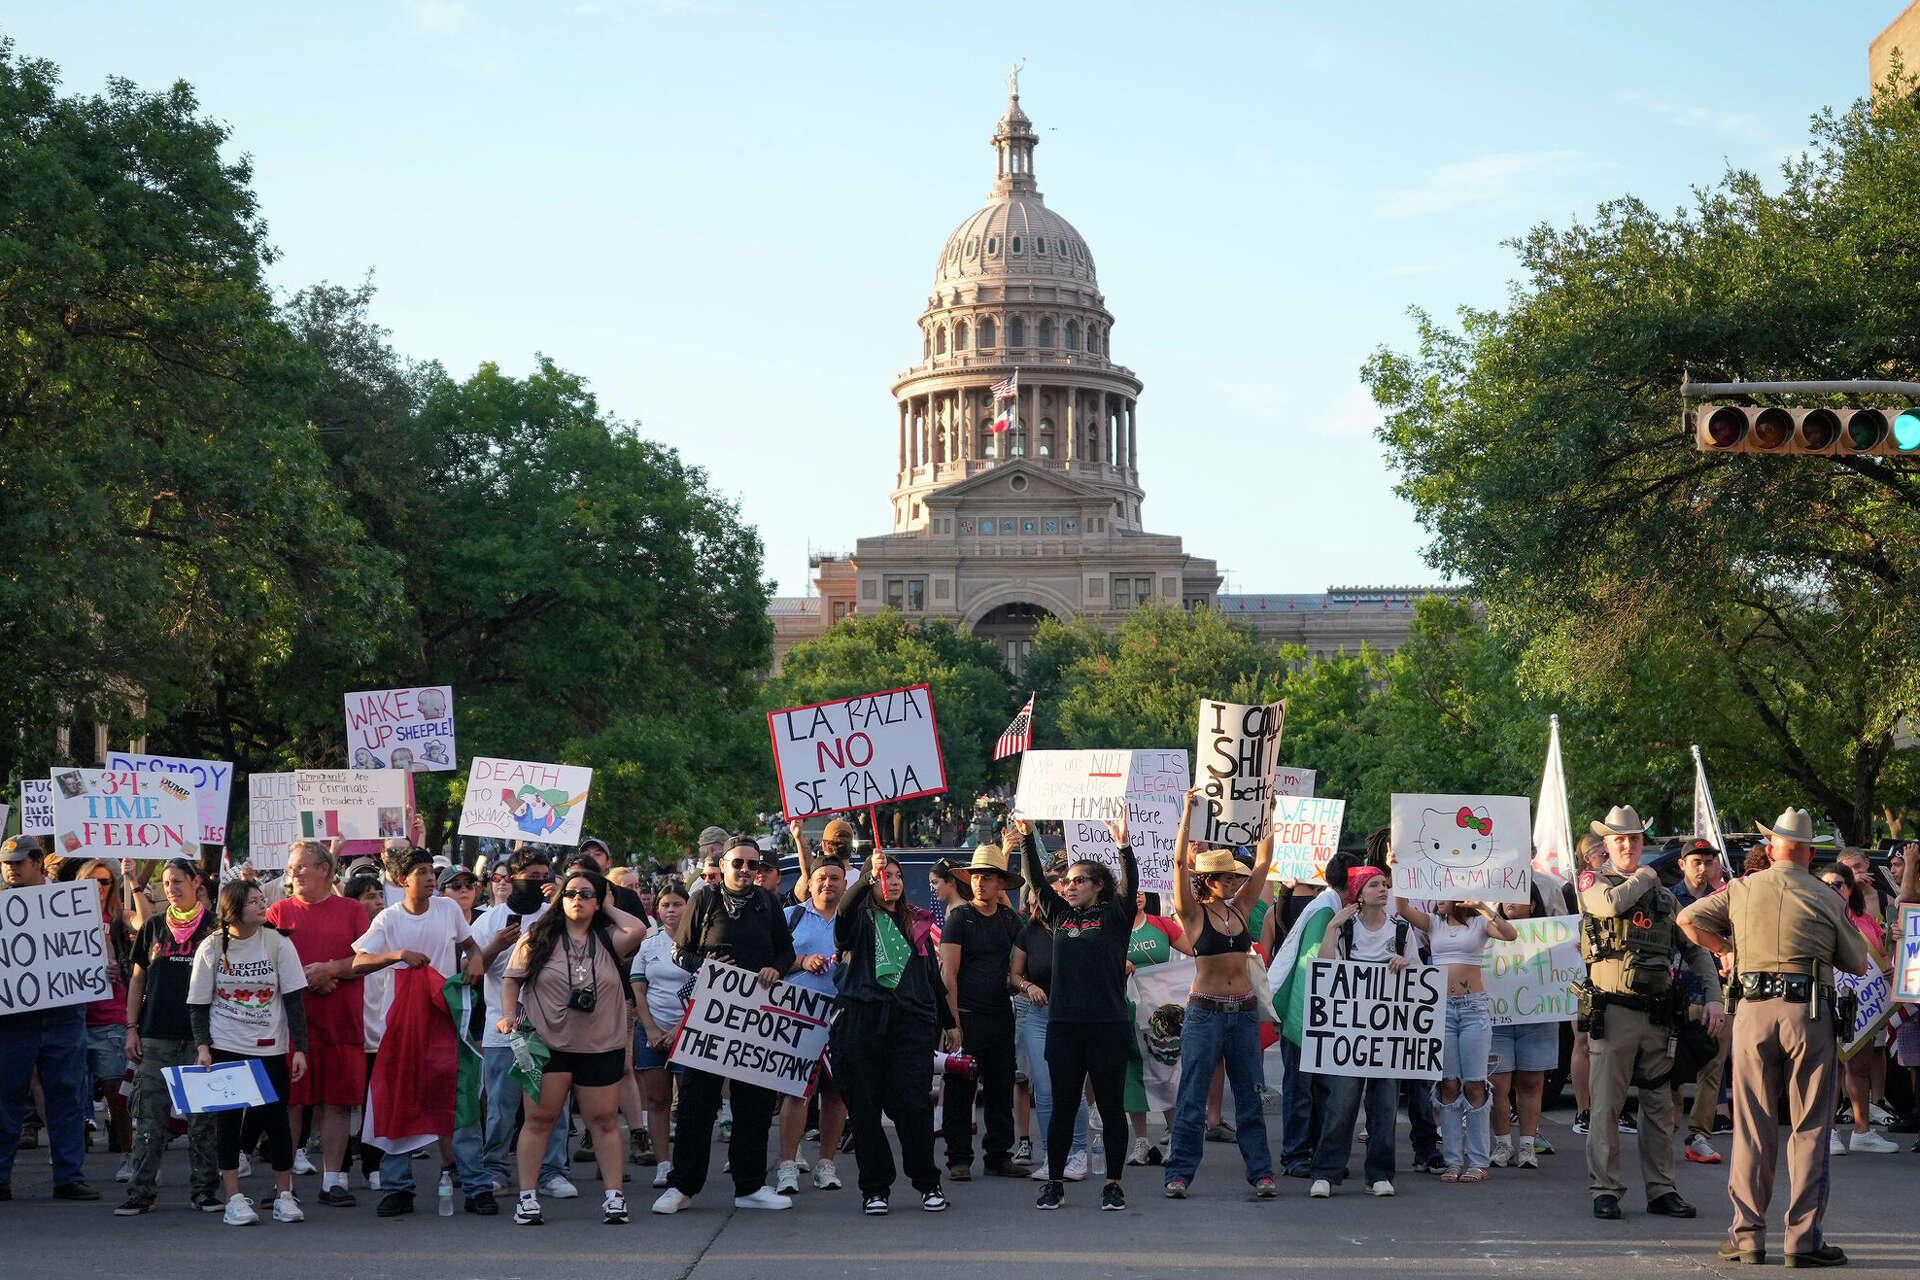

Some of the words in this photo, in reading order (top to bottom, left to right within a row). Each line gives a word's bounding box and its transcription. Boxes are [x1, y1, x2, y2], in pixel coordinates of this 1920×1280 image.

[347, 691, 414, 731] WAKE
[786, 705, 835, 742] LA
[844, 689, 923, 731] RAZA
[1210, 703, 1226, 735] I
[363, 725, 393, 750] UP
[396, 717, 453, 741] SHEEPLE!
[816, 732, 874, 773] NO
[1090, 753, 1122, 774] NOT
[1157, 753, 1185, 775] IS
[1206, 735, 1277, 779] SHIT
[101, 772, 139, 796] 34
[297, 783, 311, 792] Not
[475, 760, 561, 788] DEATH
[25, 794, 47, 804] NO
[297, 795, 314, 806] The
[471, 788, 492, 801] TO
[794, 778, 833, 816] SE
[839, 764, 923, 808] RAJA
[1231, 778, 1272, 801] bette
[82, 796, 162, 819] TIME
[1071, 796, 1125, 819] HUMANS
[1129, 803, 1164, 825] Here.
[1280, 799, 1311, 822] WE
[1312, 800, 1341, 823] THE
[82, 822, 184, 849] FELON
[1147, 831, 1175, 851] Ther
[1313, 846, 1331, 861] NO
[1140, 879, 1175, 890] IMMIGRAN
[1143, 867, 1160, 879] FREE
[1280, 863, 1312, 879] KING
[1395, 866, 1455, 893] CHINGA
[1467, 866, 1527, 893] MIGRA
[38, 886, 92, 920] ICE
[42, 927, 103, 961] NAZIS
[47, 965, 106, 1000] KINGS
[706, 963, 759, 998] YOU
[1311, 962, 1439, 1005] FAMILIES
[704, 998, 815, 1049] DEPORT
[1309, 996, 1434, 1034] BELONG
[681, 1026, 725, 1061] THE
[1306, 1030, 1443, 1072] TOGETHER
